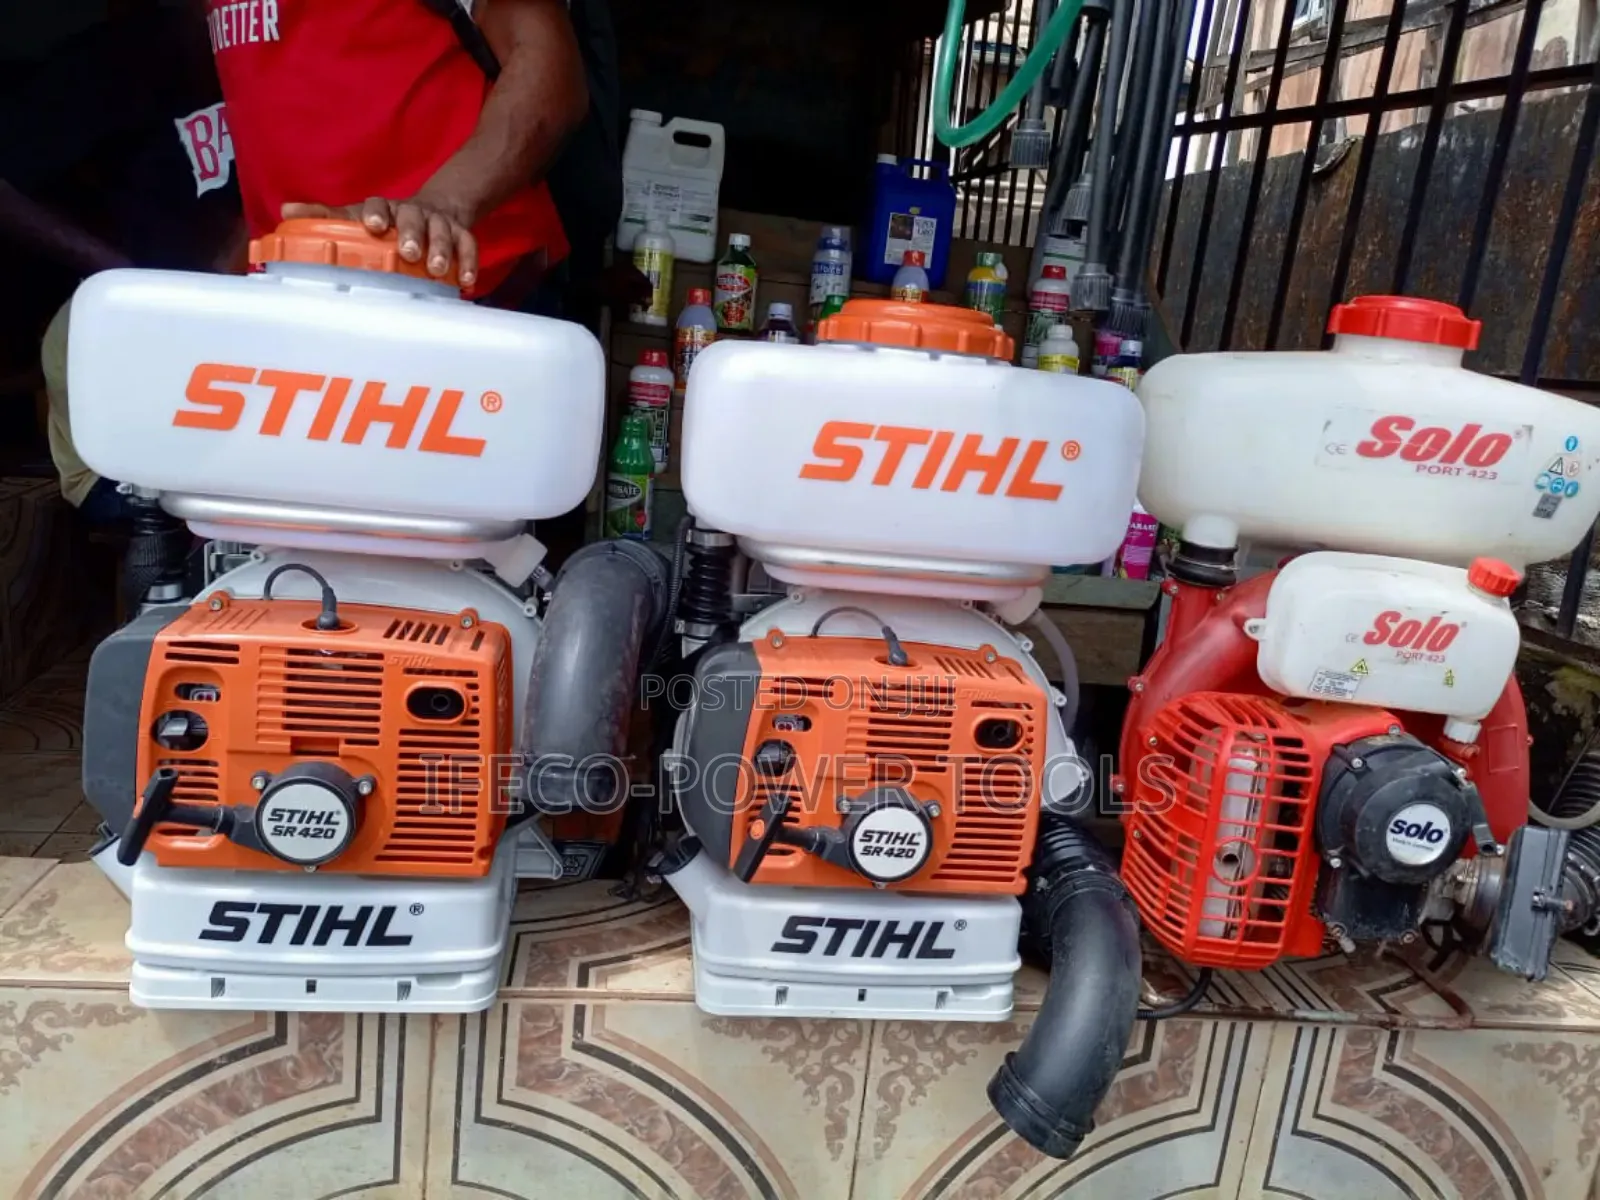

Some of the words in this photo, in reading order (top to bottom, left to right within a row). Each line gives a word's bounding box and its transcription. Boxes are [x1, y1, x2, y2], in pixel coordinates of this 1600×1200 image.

[172, 363, 487, 457] STIHL
[1356, 415, 1513, 467] Solo
[798, 420, 1064, 501] STIHL
[1416, 464, 1464, 477] PORT
[1466, 468, 1498, 481] 423
[1363, 610, 1460, 651] Solo
[1396, 650, 1425, 661] PORT
[1426, 653, 1446, 664] 423
[268, 808, 340, 826] STIHL
[270, 825, 298, 837] SR
[298, 827, 337, 839] 420
[859, 829, 921, 846] STIHL
[1390, 819, 1444, 844] solo
[860, 845, 884, 857] SR
[884, 847, 917, 859] 420
[198, 901, 413, 946] STIHL
[770, 915, 956, 959] STIHL
